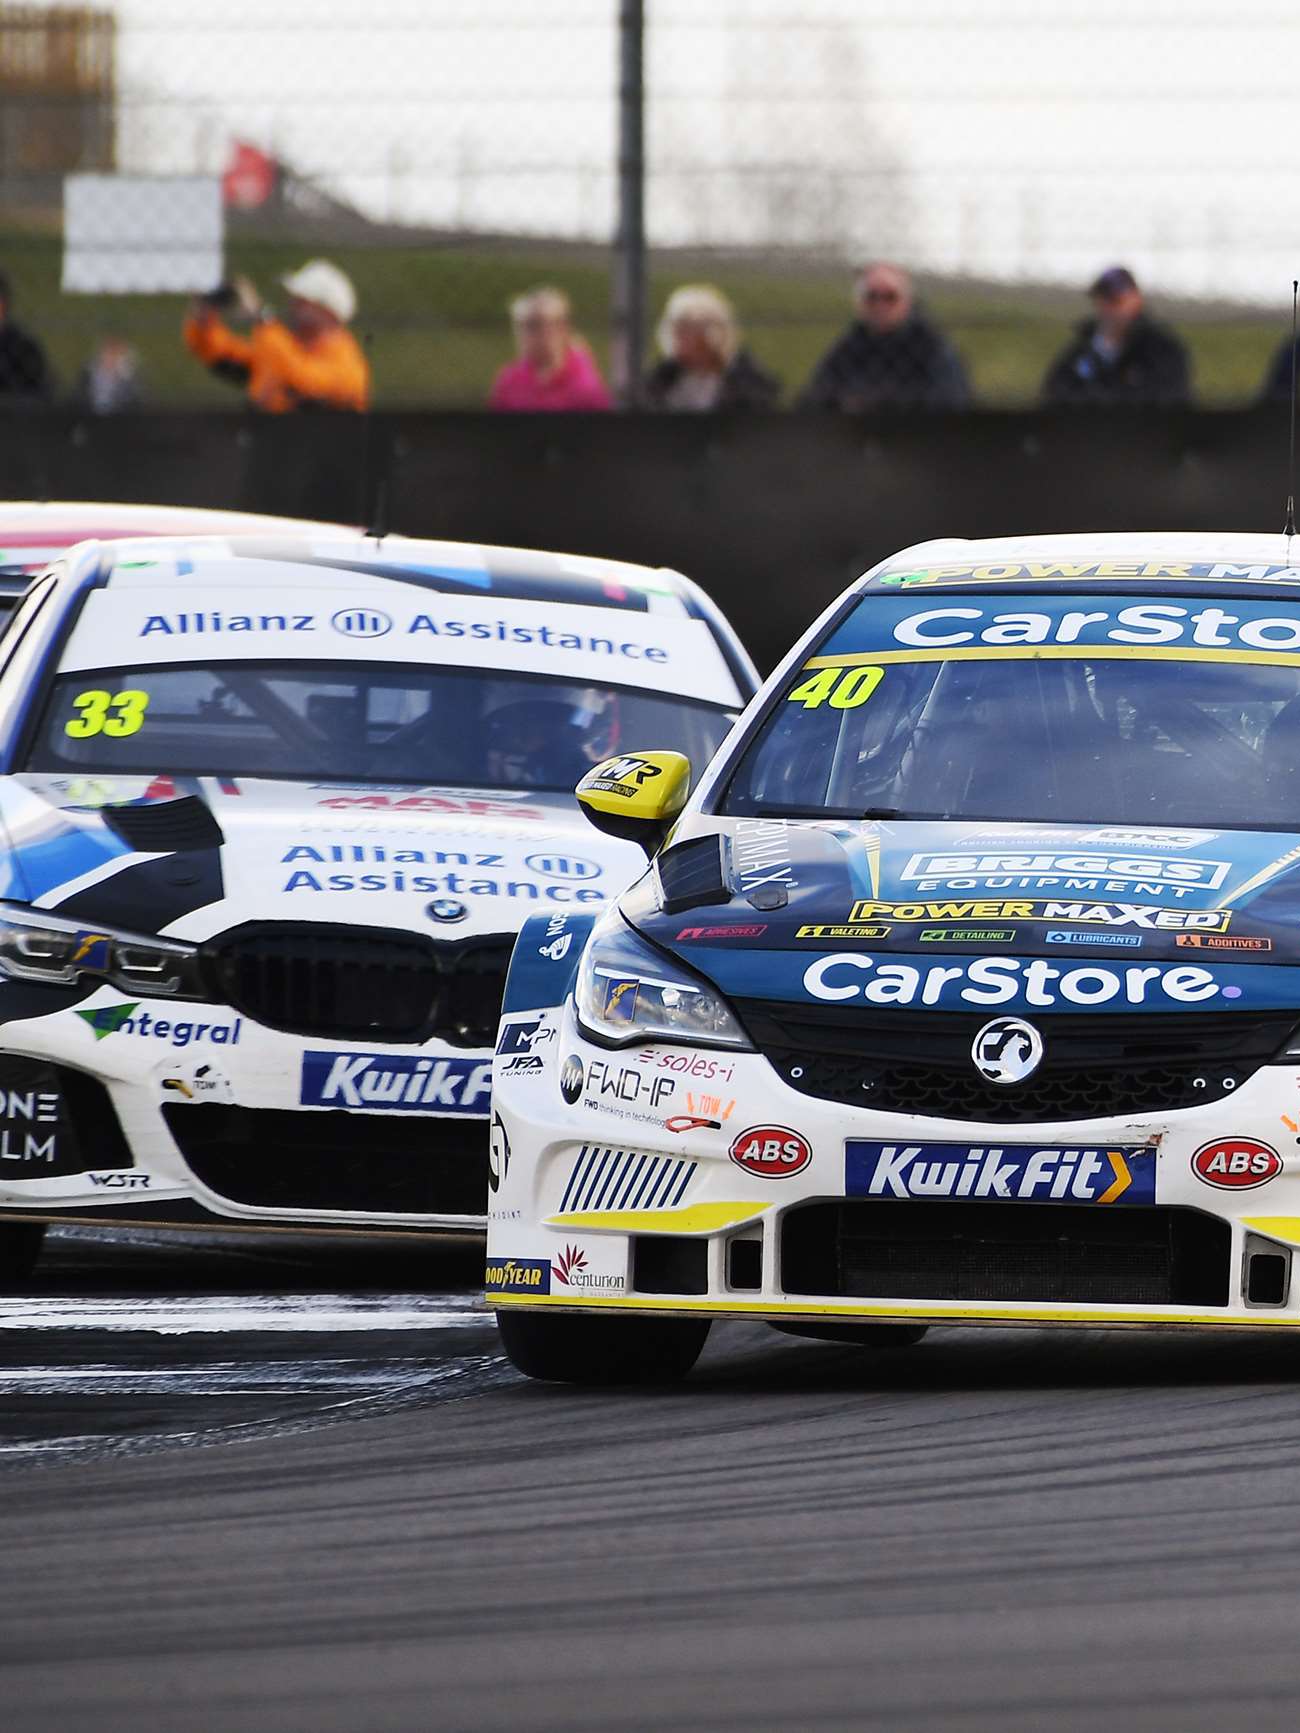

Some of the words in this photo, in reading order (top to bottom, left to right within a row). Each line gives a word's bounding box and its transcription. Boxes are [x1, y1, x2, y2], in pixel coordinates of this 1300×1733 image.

[918, 562, 1193, 579] POWER
[139, 611, 316, 638] Allianz
[408, 614, 669, 664] Assistance
[787, 666, 885, 709] 40
[65, 690, 149, 738] 33
[281, 845, 504, 867] Allianz
[925, 855, 1204, 882] BRIGGS
[284, 871, 604, 903] Assistance
[916, 876, 1195, 898] EQUIPMENT
[859, 901, 1034, 920] POWER
[1043, 903, 1222, 930] MAXED
[829, 926, 878, 937] VALETING
[951, 930, 1005, 940] DETAILING
[1071, 933, 1138, 946] LUBRICANTS
[1206, 936, 1263, 949] ADDITIVES
[502, 1056, 544, 1070] JFA
[657, 1051, 736, 1083] sales-i
[586, 1061, 676, 1107] FWD-IP
[584, 1098, 599, 1110] FWD
[699, 1094, 722, 1117] TOW
[741, 1138, 800, 1164] ABS
[1206, 1151, 1270, 1174] ABS
[89, 1173, 151, 1188] WSR
[570, 1273, 625, 1289] centurion
